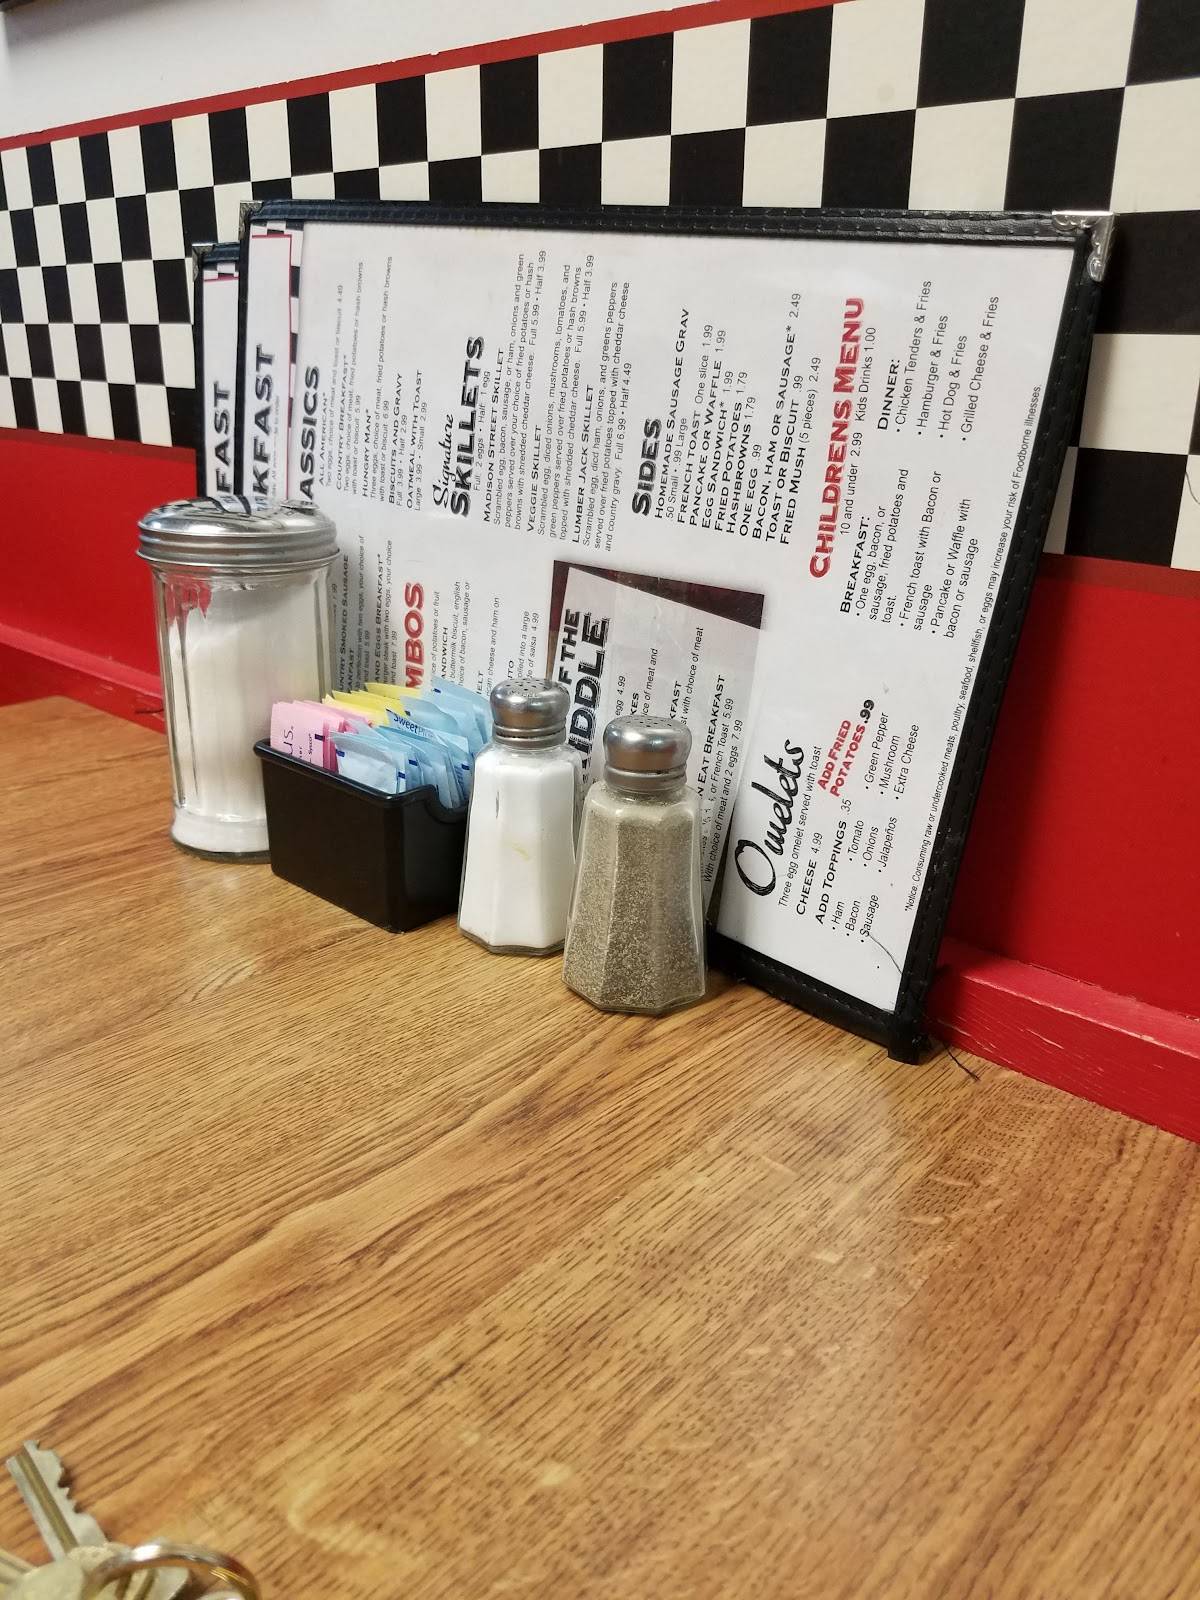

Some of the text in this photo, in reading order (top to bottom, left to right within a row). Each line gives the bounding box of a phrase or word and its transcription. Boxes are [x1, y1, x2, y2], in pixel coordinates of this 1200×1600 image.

[877, 359, 900, 430] DINNER:
[894, 281, 932, 425] Chicken Tenders & Fries
[915, 315, 948, 428] Hamburger & Fries
[937, 335, 967, 430] Hot Dog & Fries
[960, 296, 999, 433] Grilled Cheese & Fries
[213, 381, 232, 494] FAST
[252, 343, 275, 496] KFAST
[299, 366, 319, 500] ASSICS
[388, 449, 396, 504] BISCUITS
[393, 373, 402, 416] GRAVY
[406, 370, 422, 509] OATMEAL WITH TOAST
[450, 336, 484, 517] SKILLETS
[483, 348, 504, 522] MADISON STREET SKILLET
[654, 308, 689, 519] HOMEMADE SAUSAGE GRAV
[674, 417, 688, 447] Large
[676, 324, 713, 524] FRENCH TOAST One slice 1.99
[689, 330, 725, 526] PANCAKE OR WAFFLE 1.99
[701, 497, 714, 529] EGG
[722, 371, 733, 392] 1.99
[751, 480, 772, 540] BACON,
[763, 440, 777, 475] HAM
[771, 413, 782, 436] OR
[788, 293, 801, 318] 2.49
[809, 297, 864, 578] CHILDRENS MENU
[839, 327, 876, 535] 10 and under 2.99 Kids Drinks 1.00
[1024, 386, 1041, 426] illnesses.
[432, 414, 456, 509] Signature
[526, 424, 541, 532] VEGGIE SKILLET
[571, 384, 593, 543] LUMBER JACK SKILLET
[631, 418, 662, 516] SIDES
[667, 475, 680, 504] Small
[672, 449, 683, 466] .99
[714, 371, 747, 531] FRIED POTATOES 1.79
[725, 396, 756, 534] HASHBROWNS 1.79
[739, 444, 762, 537] ONE EGG .99
[764, 375, 804, 542] TOAST OR BISCUIT .99
[779, 357, 821, 545] FRIED MUSH (5 pieces) 2.49
[1010, 479, 1020, 490] of
[1012, 428, 1032, 478] Foodborne
[1002, 509, 1013, 529] your
[1007, 491, 1018, 507] risk
[839, 516, 870, 613] BREAKFAST:
[855, 505, 886, 609] One egg, bacon, or
[869, 468, 909, 620] sausage, fried potatoes and
[987, 570, 999, 590] may
[990, 531, 1008, 569] increase
[403, 582, 424, 690] MBOS
[559, 608, 580, 662] THE
[880, 595, 897, 623] toast.
[967, 627, 985, 663] shellfish,
[978, 614, 987, 624] or
[981, 591, 994, 613] eggs
[566, 612, 610, 755] IDDLE
[703, 674, 725, 754] BREAKFAST
[951, 703, 965, 732] poultry,
[958, 665, 975, 700] seafood,
[697, 756, 710, 784] EAT
[817, 719, 851, 790] ADD FRIED
[829, 699, 875, 797] POTATOES .99
[864, 712, 888, 783] Green Pepper
[878, 735, 900, 789] Mushroom
[893, 724, 919, 794] Extra Cheese
[931, 760, 949, 812] undercooked
[943, 734, 957, 760] meats,
[734, 739, 804, 897] Omelets
[777, 745, 822, 906] Three egg omelet served with toast
[847, 820, 864, 854] Tomato
[862, 826, 879, 861] Onions
[876, 816, 897, 867] Jalapeños
[911, 839, 931, 882] Consuming
[924, 822, 933, 838] raw
[928, 812, 935, 822] or
[796, 832, 823, 915] CHEESE 4.99
[814, 798, 852, 925] ADD TOPPINGS .35
[831, 901, 845, 924] Ham
[844, 900, 860, 931] Bacon
[859, 894, 879, 937] Sausage
